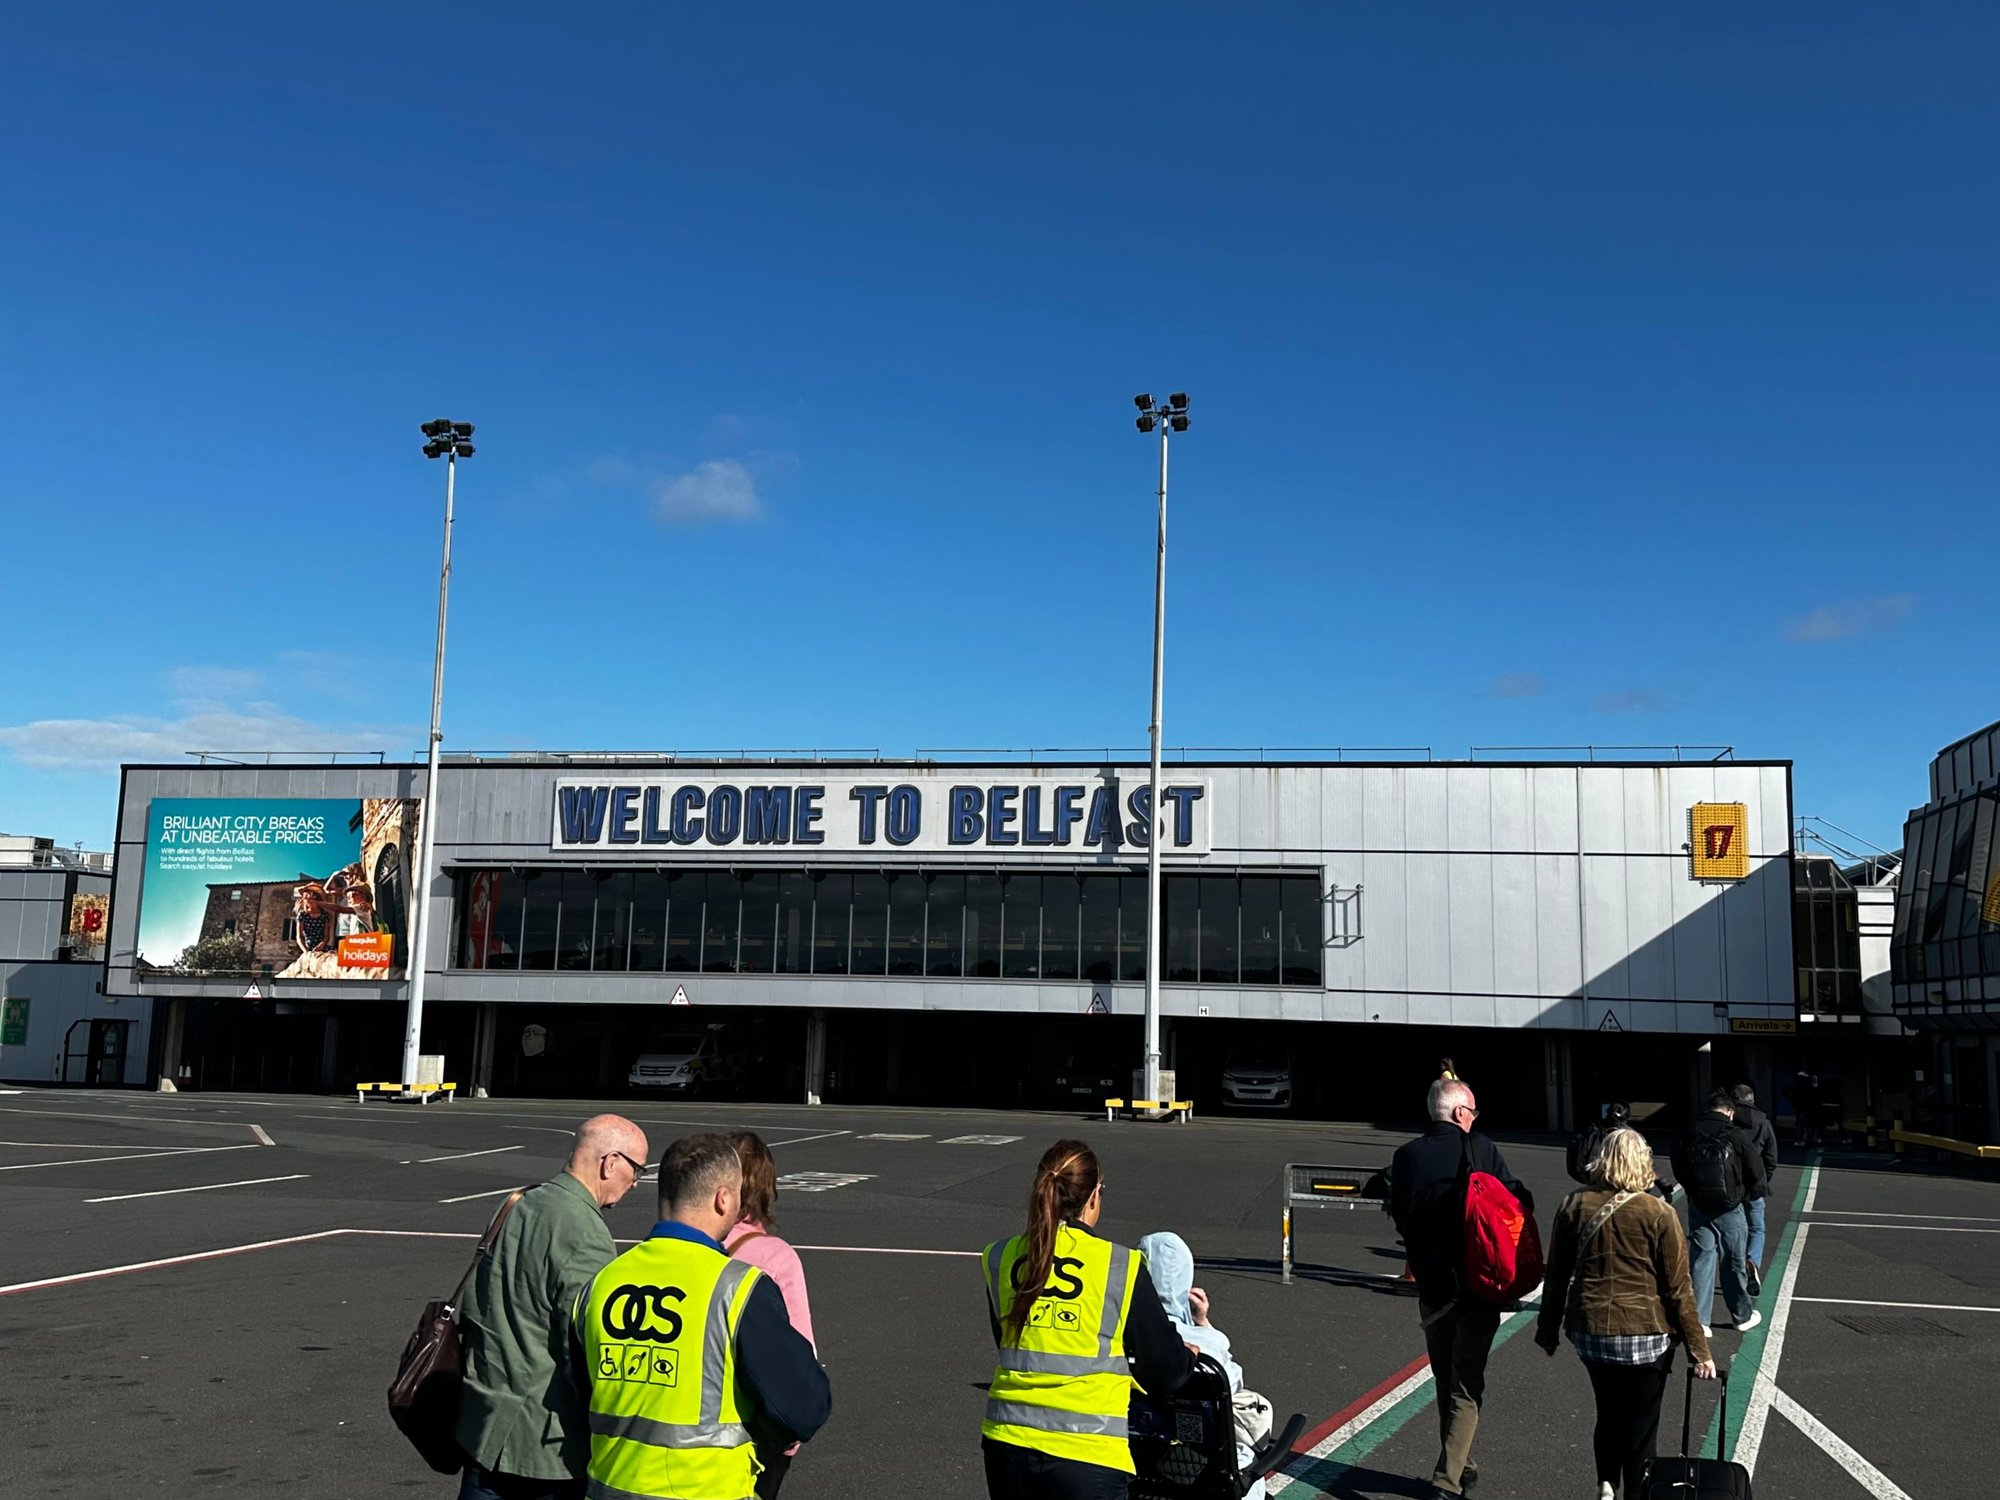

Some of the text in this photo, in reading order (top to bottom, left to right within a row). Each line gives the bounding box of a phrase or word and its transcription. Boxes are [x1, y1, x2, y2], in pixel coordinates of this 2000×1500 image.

[163, 816, 324, 830] BRILLIANT CITY BREAKS
[558, 784, 1205, 848] WELCOME TO BELFAST
[160, 830, 326, 844] AT UNBEATABLE PRICES.
[1703, 825, 1735, 860] 17
[161, 847, 255, 856] With direct flights from Belfast
[160, 862, 181, 870] Search
[206, 863, 233, 871] holidays
[343, 949, 388, 963] holidays
[1200, 1007, 1208, 1015] H
[1739, 1020, 1780, 1030] Arrivals
[602, 1284, 687, 1344] OCS
